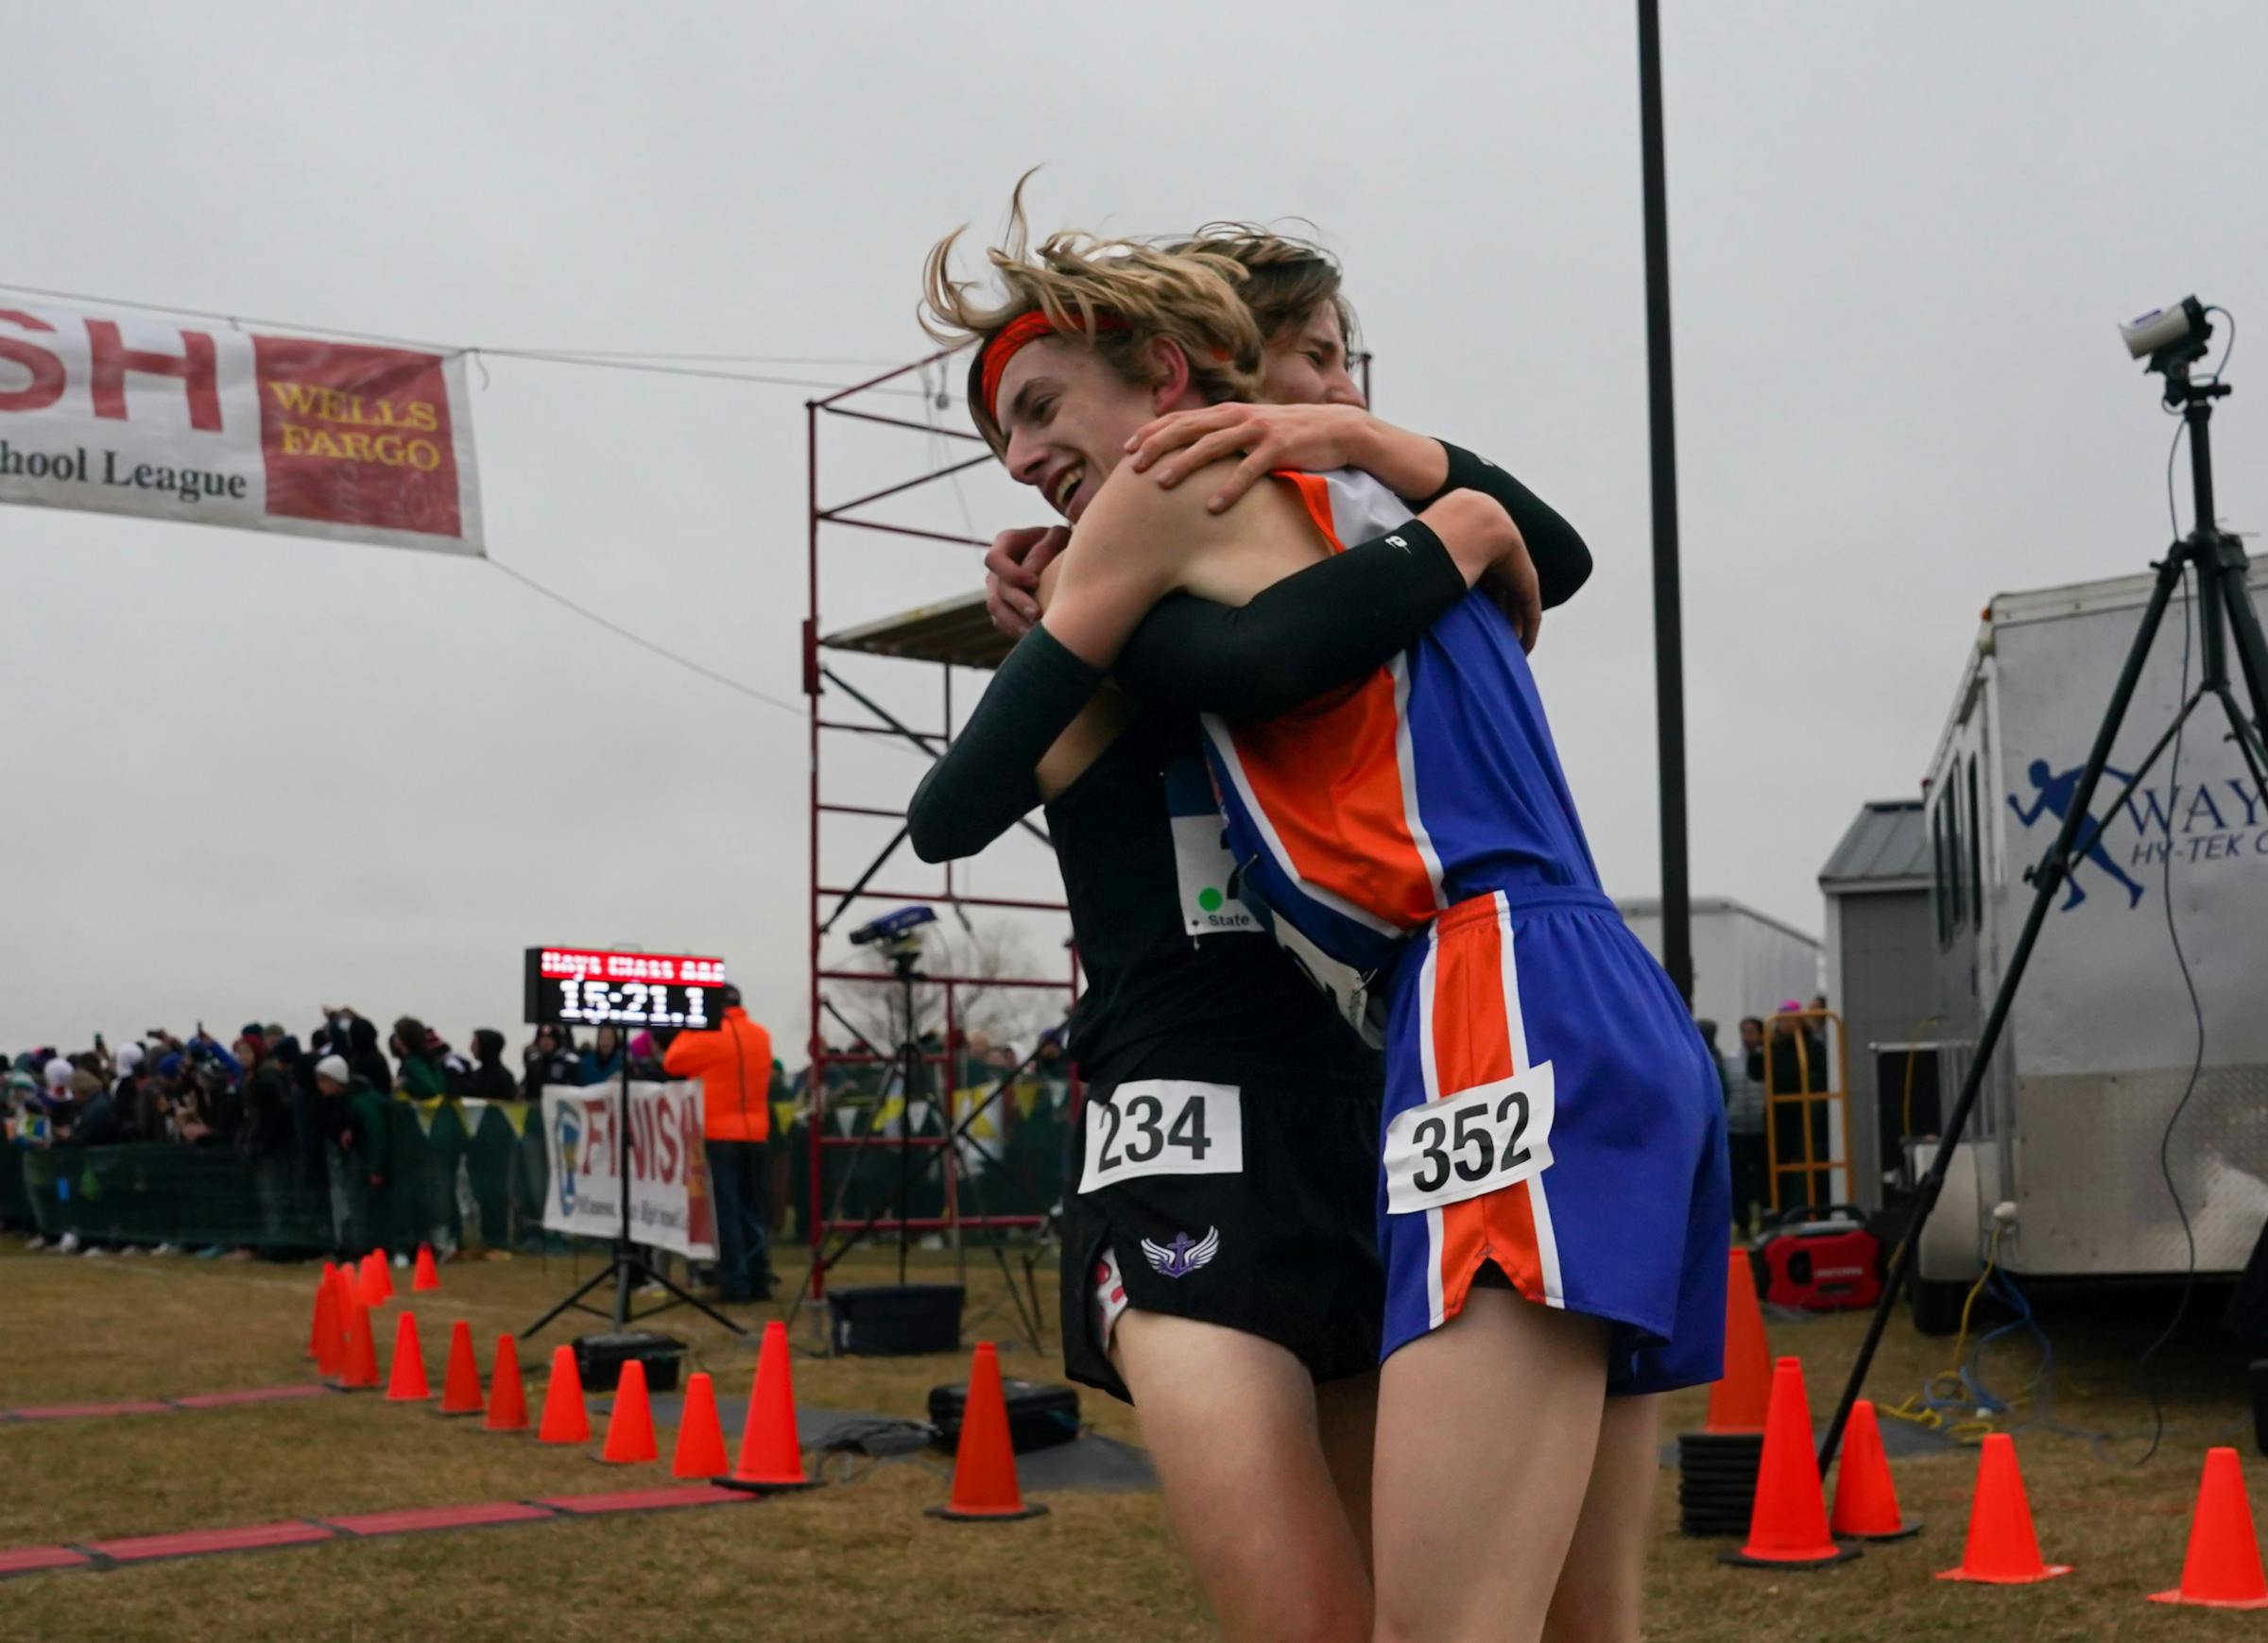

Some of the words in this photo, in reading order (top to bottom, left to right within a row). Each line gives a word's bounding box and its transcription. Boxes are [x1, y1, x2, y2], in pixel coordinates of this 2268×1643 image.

[268, 381, 438, 431] WELLS
[282, 424, 440, 470] FARGO
[103, 450, 247, 503] League
[2131, 832, 2244, 867] HY-TEK
[1208, 915, 1249, 926] State
[1098, 1096, 1211, 1173] 234
[1412, 1091, 1532, 1192] 352
